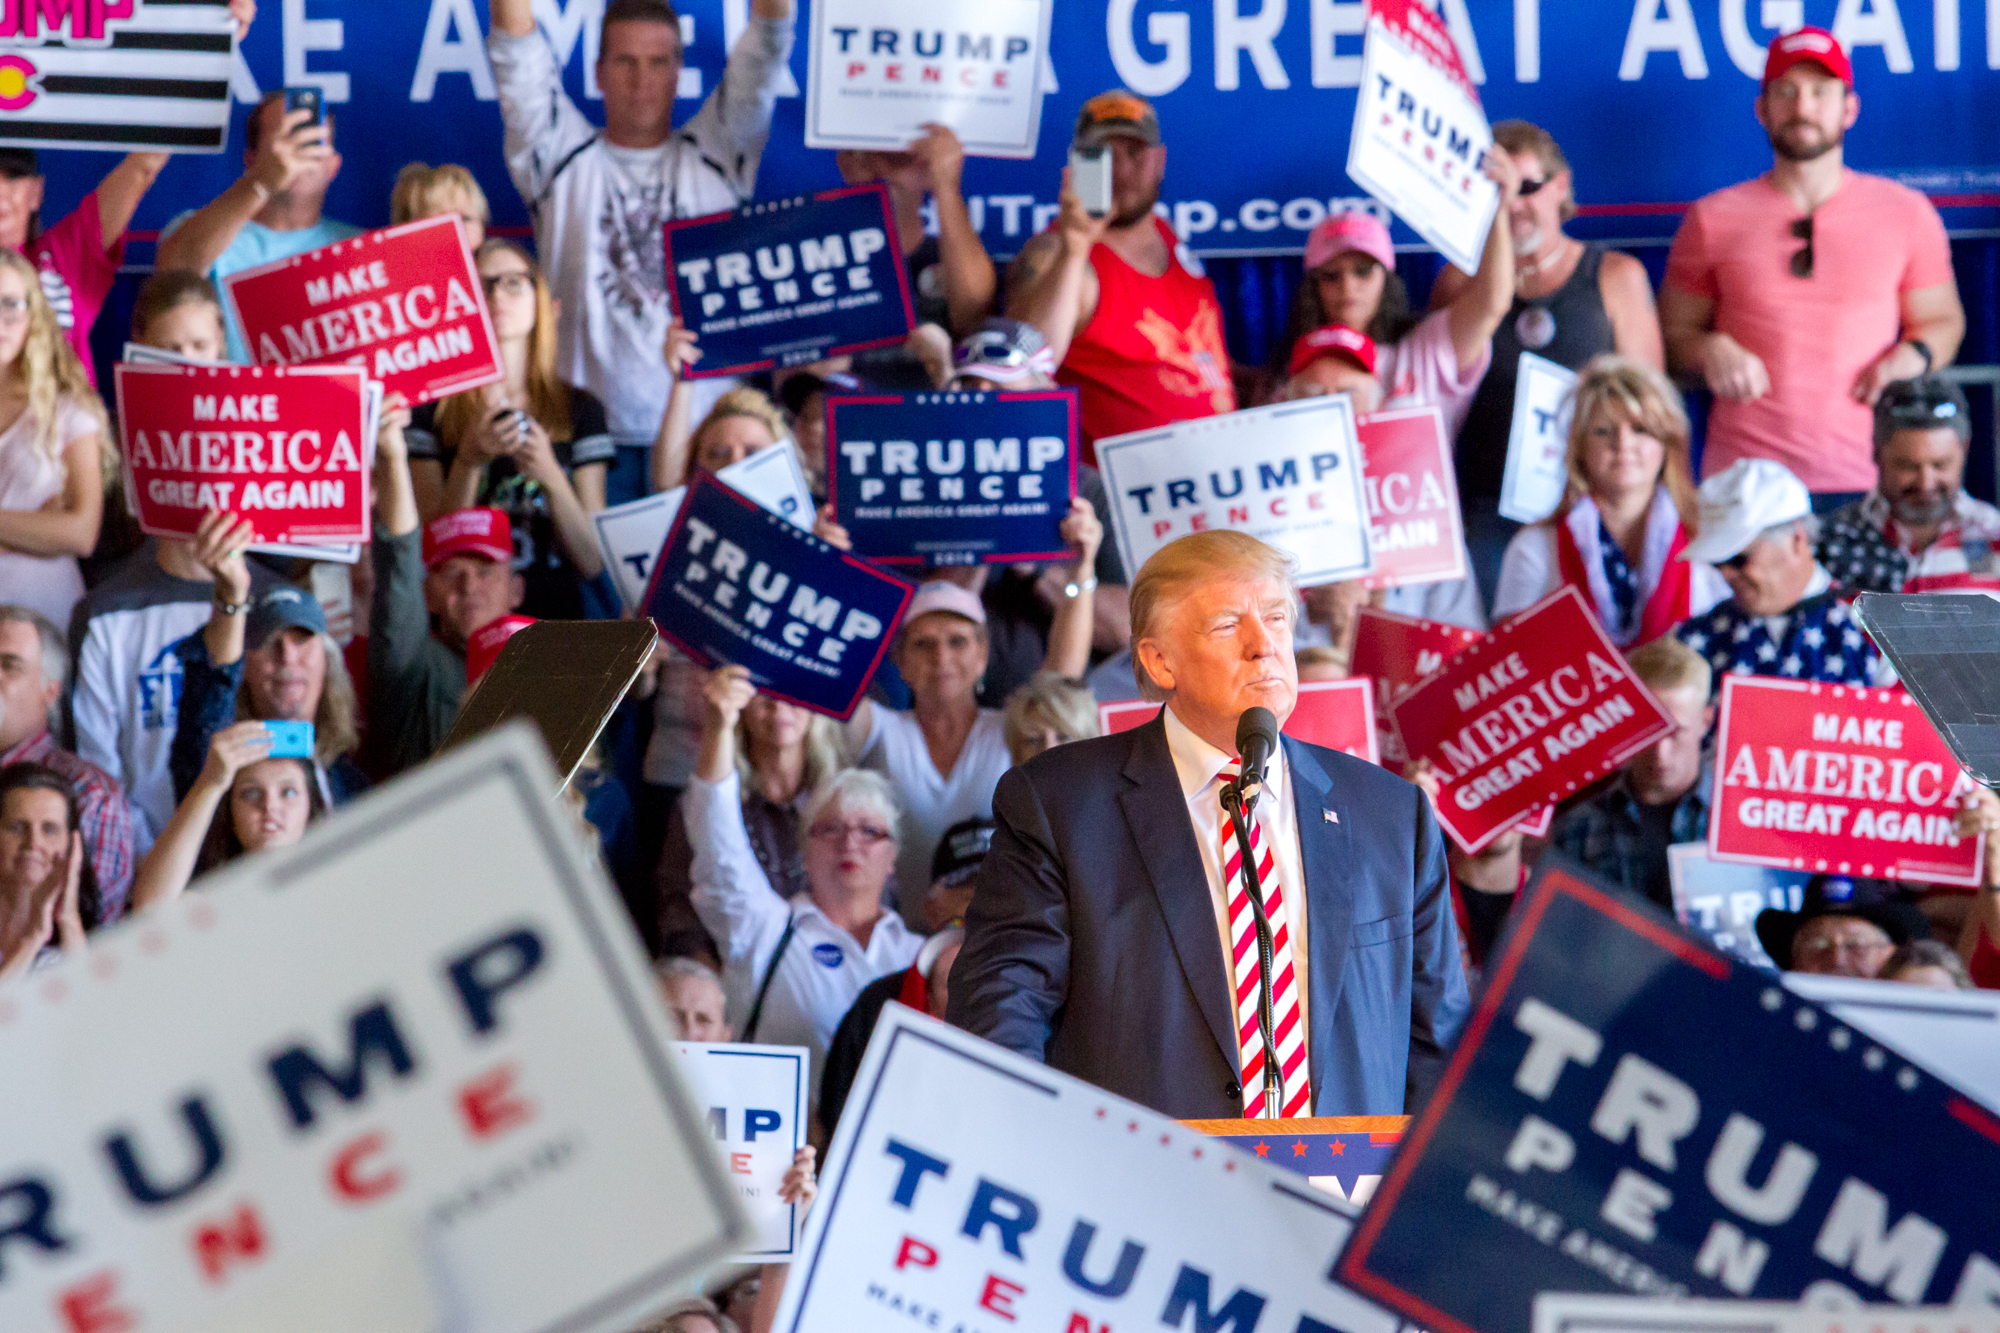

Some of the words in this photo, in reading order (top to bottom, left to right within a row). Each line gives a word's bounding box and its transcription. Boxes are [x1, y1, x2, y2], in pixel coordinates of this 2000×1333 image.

[832, 27, 1029, 61] TRUMP
[847, 62, 1008, 88] PENCE
[304, 260, 390, 306] MAKE
[677, 227, 886, 294] TRUMP
[701, 265, 873, 317] PENCE
[258, 277, 478, 366] AMERICA
[374, 326, 473, 378] AGAIN
[193, 394, 280, 422] MAKE
[132, 429, 360, 474] AMERICA
[840, 436, 1066, 476] TRUMP
[148, 478, 236, 511] GREAT
[239, 479, 345, 510] AGAIN
[860, 474, 1044, 501] PENCE
[1127, 452, 1340, 515] TRUMP
[1153, 490, 1325, 540] PENCE
[1367, 518, 1439, 553] GAIN
[685, 516, 884, 643] TRUMP
[683, 560, 847, 665] PENCE
[1453, 651, 1530, 713] MAKE
[1454, 747, 1544, 811] GREAT
[1541, 693, 1636, 763] AGAIN
[1811, 712, 1905, 750] MAKE
[1737, 796, 1849, 836] GREAT
[1690, 884, 1803, 932] TRU
